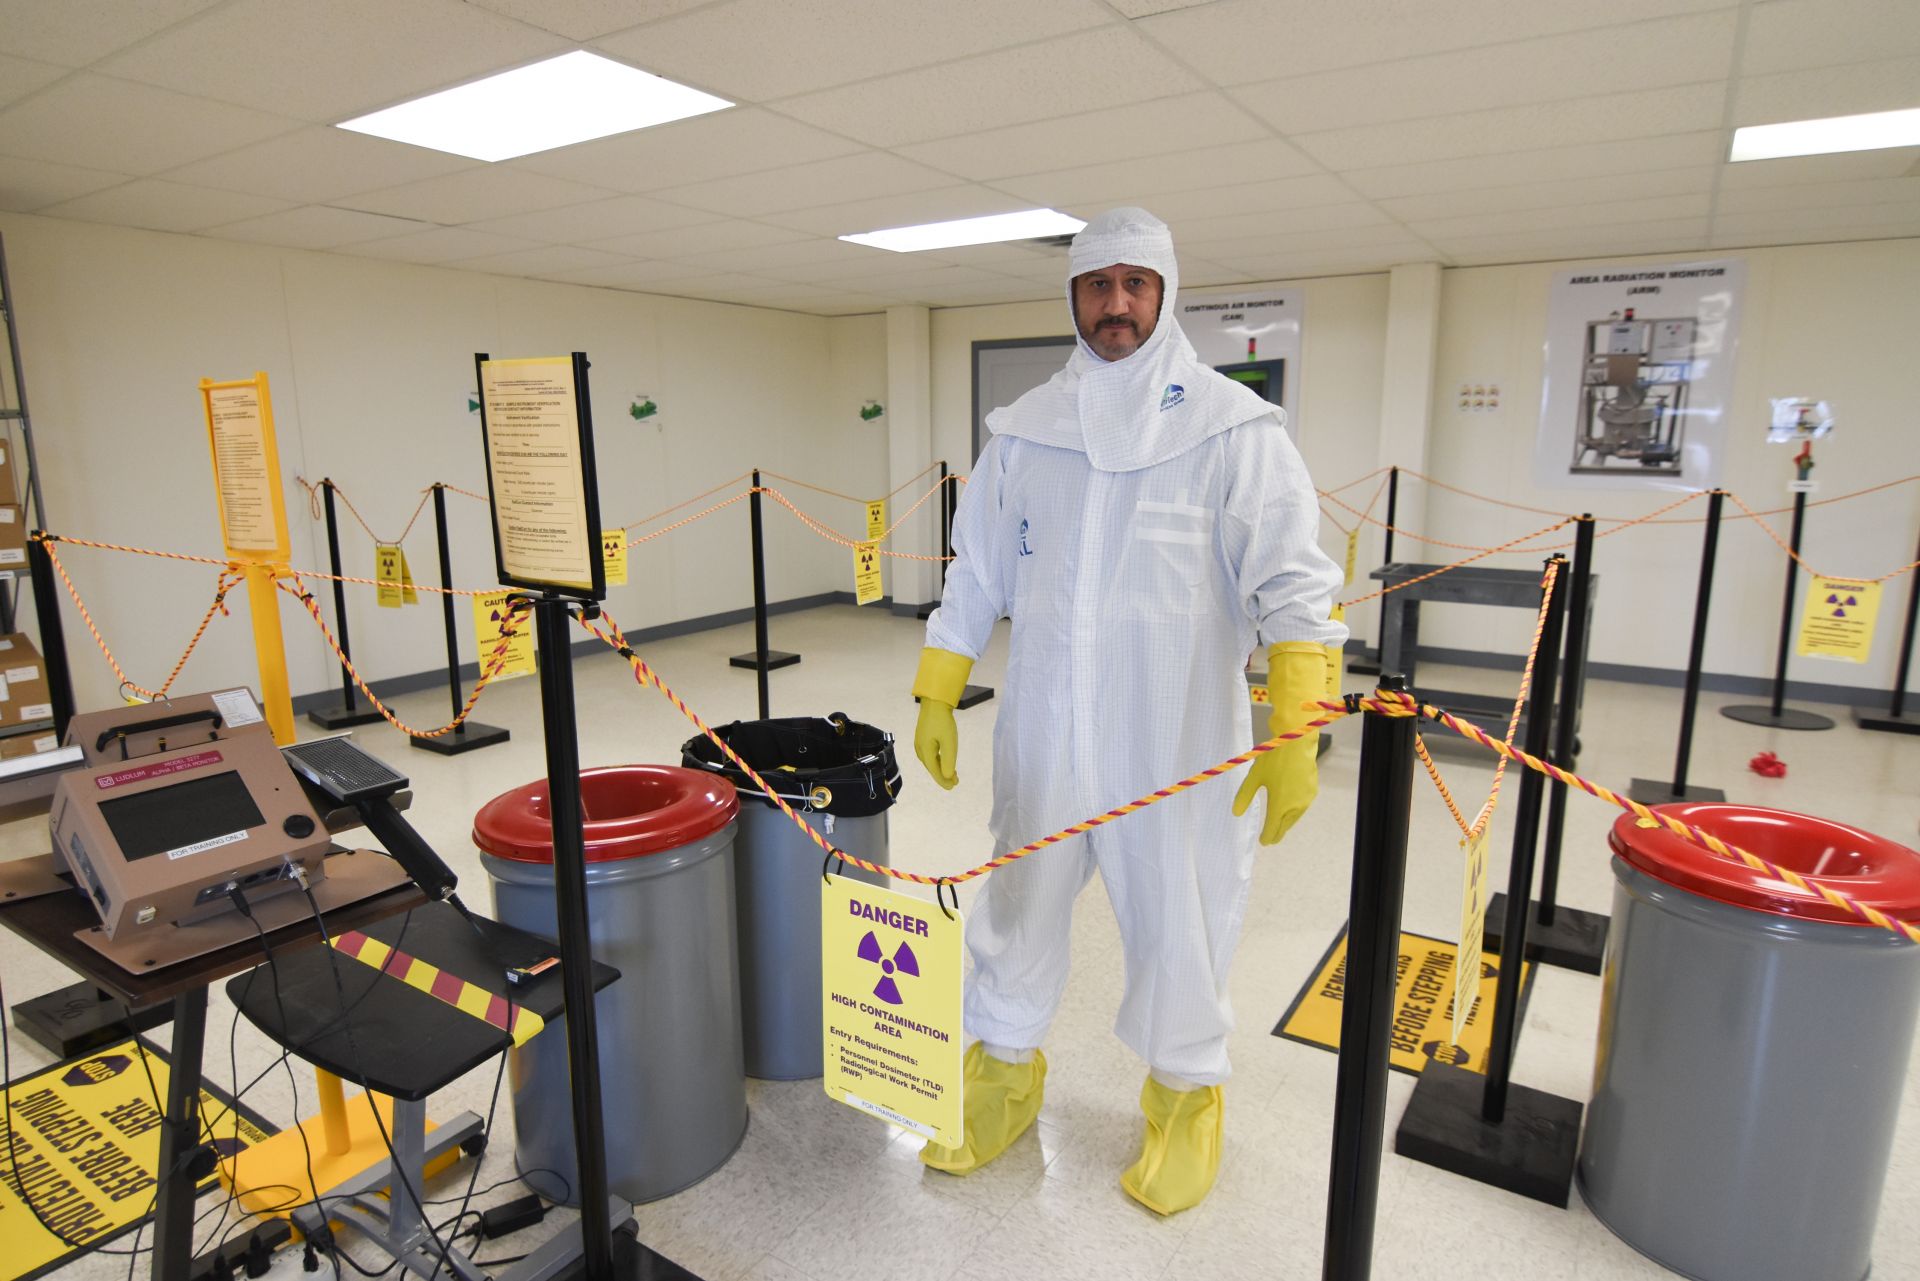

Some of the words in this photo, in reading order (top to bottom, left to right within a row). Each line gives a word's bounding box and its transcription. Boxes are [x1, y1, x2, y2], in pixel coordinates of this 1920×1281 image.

[1569, 275, 1599, 285] AREA
[1602, 272, 1666, 283] RADIATION
[1668, 268, 1726, 279] MONITOR
[1627, 285, 1661, 296] (ARM)
[1246, 299, 1284, 308] MONITOR
[115, 770, 146, 782] LUDLUM
[152, 767, 171, 776] ALPHA
[176, 763, 192, 771] BETA
[192, 756, 219, 766] MONITOR
[164, 759, 185, 767] MODEL
[171, 849, 188, 857] FOR
[190, 838, 225, 852] TRAINING
[225, 832, 245, 841] ONLY
[850, 899, 929, 938] DANGER
[1408, 951, 1455, 1005] STEPPING
[831, 992, 857, 1009] HIGH
[860, 1002, 949, 1042] CONTAMINATION
[874, 1021, 902, 1039] AREA
[1391, 1002, 1433, 1054] BEFORE
[830, 1026, 853, 1042] Entry
[854, 1035, 918, 1066] Requirements:
[80, 1061, 116, 1081] STOP
[840, 1046, 878, 1066] Personnel
[880, 1061, 921, 1083] Dosimeter
[922, 1078, 944, 1094] (TLD)
[840, 1065, 863, 1081] (RWP)
[840, 1055, 887, 1080] Radiological
[889, 1074, 908, 1089] Work
[911, 1084, 938, 1101] Permit
[10, 1088, 103, 1153] STEPPING
[100, 1097, 162, 1139] HERE
[861, 1101, 874, 1110] FOR
[874, 1106, 901, 1122] TRAINING
[901, 1117, 918, 1129] ONLY
[68, 1141, 158, 1203] BEFORE
